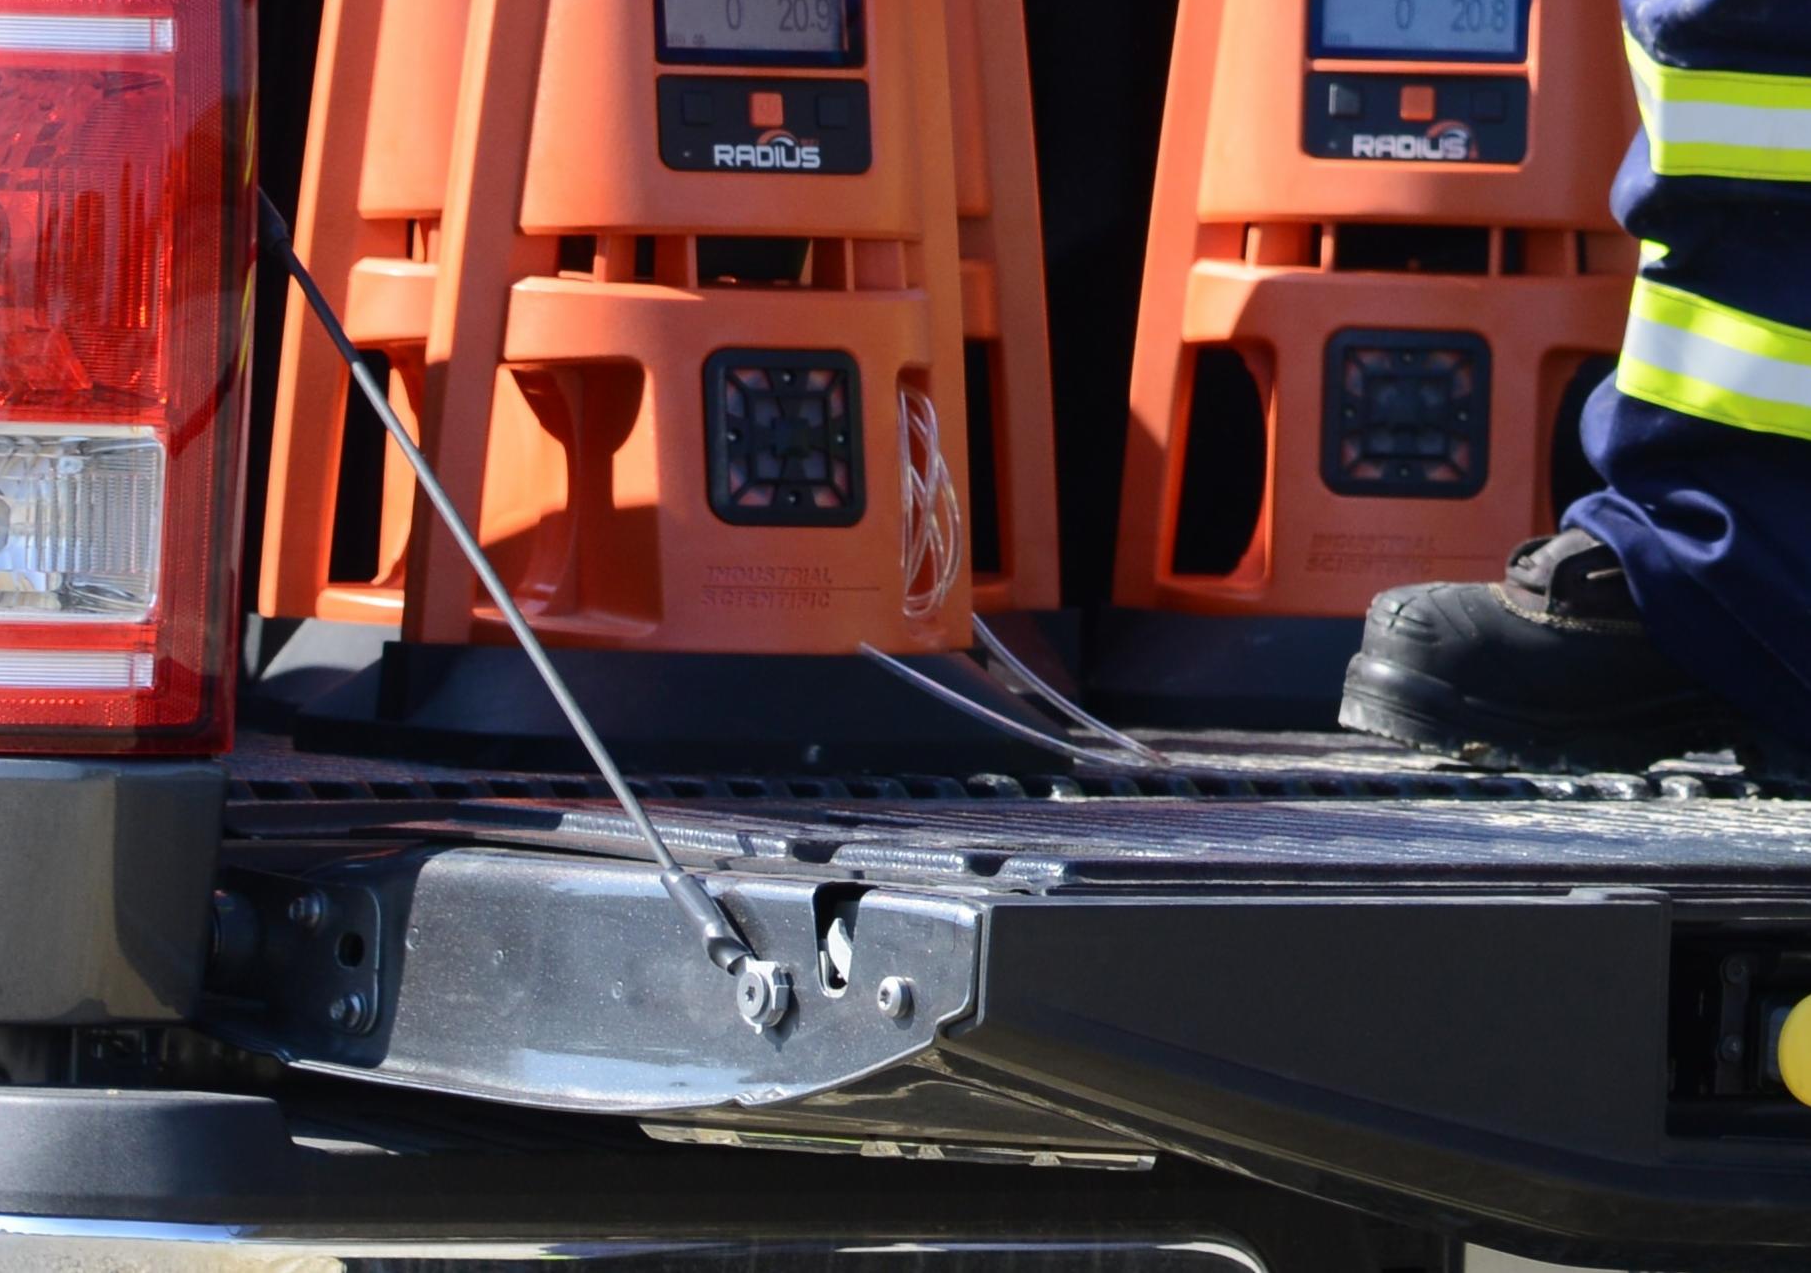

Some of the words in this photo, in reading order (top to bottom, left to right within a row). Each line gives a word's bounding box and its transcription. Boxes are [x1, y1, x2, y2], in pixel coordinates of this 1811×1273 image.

[713, 144, 821, 169] RADIUS
[1352, 134, 1468, 160] RADIUS
[706, 565, 834, 585] INDUSTRIAL
[701, 590, 831, 610] SCIENTIFIC
